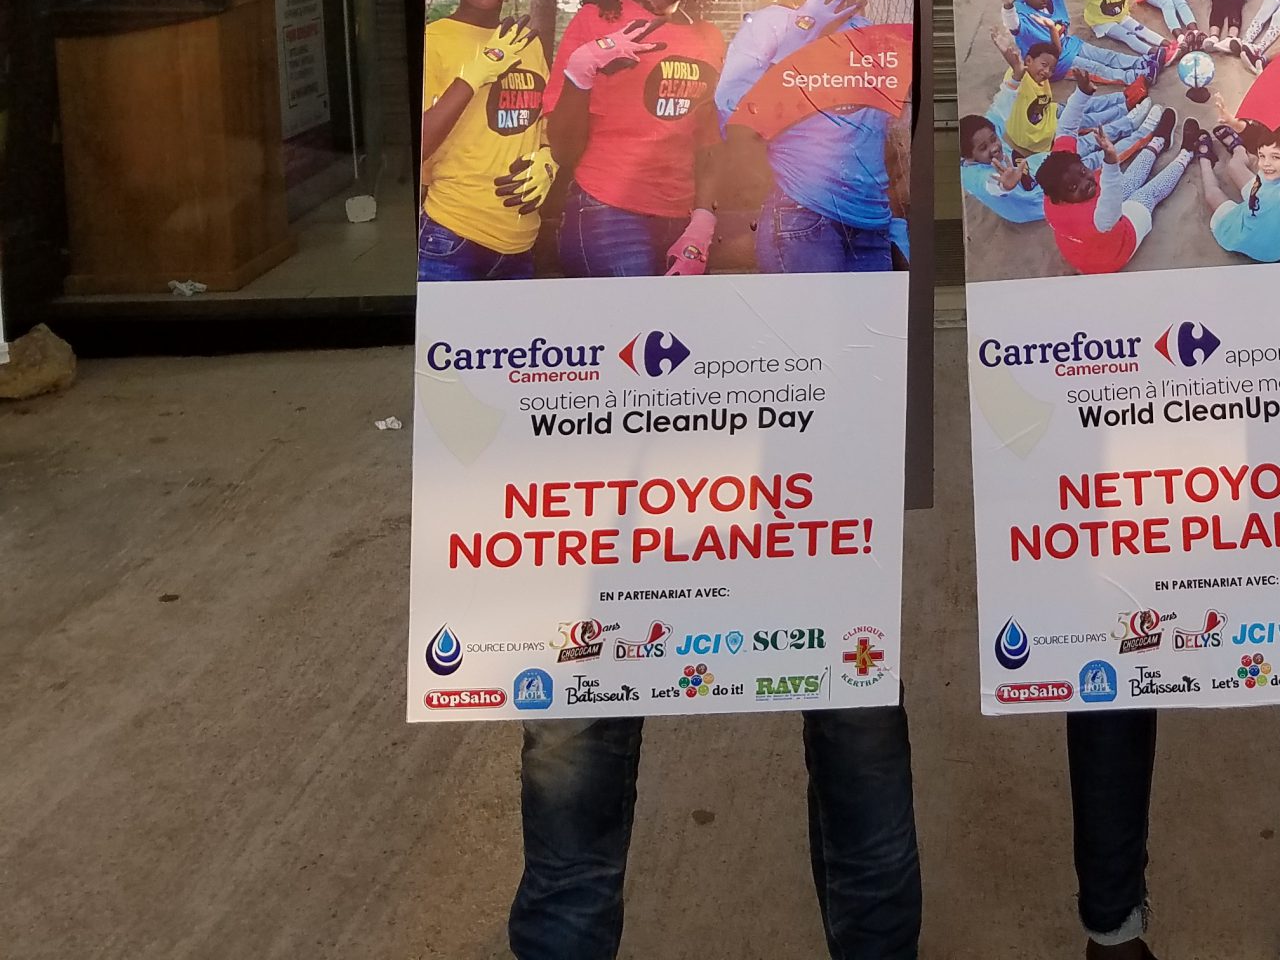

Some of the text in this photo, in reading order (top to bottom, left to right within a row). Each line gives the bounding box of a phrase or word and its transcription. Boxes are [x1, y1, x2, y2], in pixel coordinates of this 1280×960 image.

[850, 51, 898, 68] Le 15
[661, 61, 699, 80] WORLD
[782, 71, 898, 91] Septembre
[498, 110, 519, 128] DAY
[427, 337, 605, 371] Carrefour
[979, 332, 1141, 368] Carrefour
[508, 369, 600, 384] Cameroun
[694, 357, 822, 380] apporte son
[1055, 362, 1139, 377] Cameroun
[519, 384, 826, 411] soutien à l'initiative mondiale
[1066, 383, 1141, 404] soutien
[1145, 381, 1157, 399] à
[1161, 377, 1253, 397] l'initiative
[1078, 402, 1154, 428] World
[1163, 396, 1280, 424] CleanUp
[530, 406, 815, 437] World CleanUp Day
[505, 472, 814, 519] NETTOYONS
[448, 510, 873, 570] NOTRE PLANÈTE!
[1010, 517, 1171, 562] NOTRE
[1155, 575, 1279, 592] EN PARTENARIAT AVEC:
[599, 586, 731, 602] EN PARTENARIAT AVEC:
[752, 627, 826, 651] SC2R
[843, 626, 885, 641] CLINIQUE
[1033, 633, 1106, 645] SOURCE DU PAYS
[1175, 633, 1220, 649] DELYS
[1232, 623, 1274, 645] JCI
[467, 642, 545, 652] SOURCE DU PAYS
[616, 643, 665, 659] DELYS
[676, 633, 722, 655] JCI
[1122, 635, 1159, 650] CHOCOCAM
[561, 644, 600, 659] CHOCOCAM
[573, 675, 600, 691] Tous
[841, 672, 885, 688] KERTHAN
[1135, 666, 1161, 683] Tous
[1212, 677, 1239, 689] Let's
[651, 683, 744, 698] Let's do it!
[755, 675, 819, 695] RAVS
[1000, 685, 1068, 700] TopSaho
[430, 691, 501, 706] TopSaho
